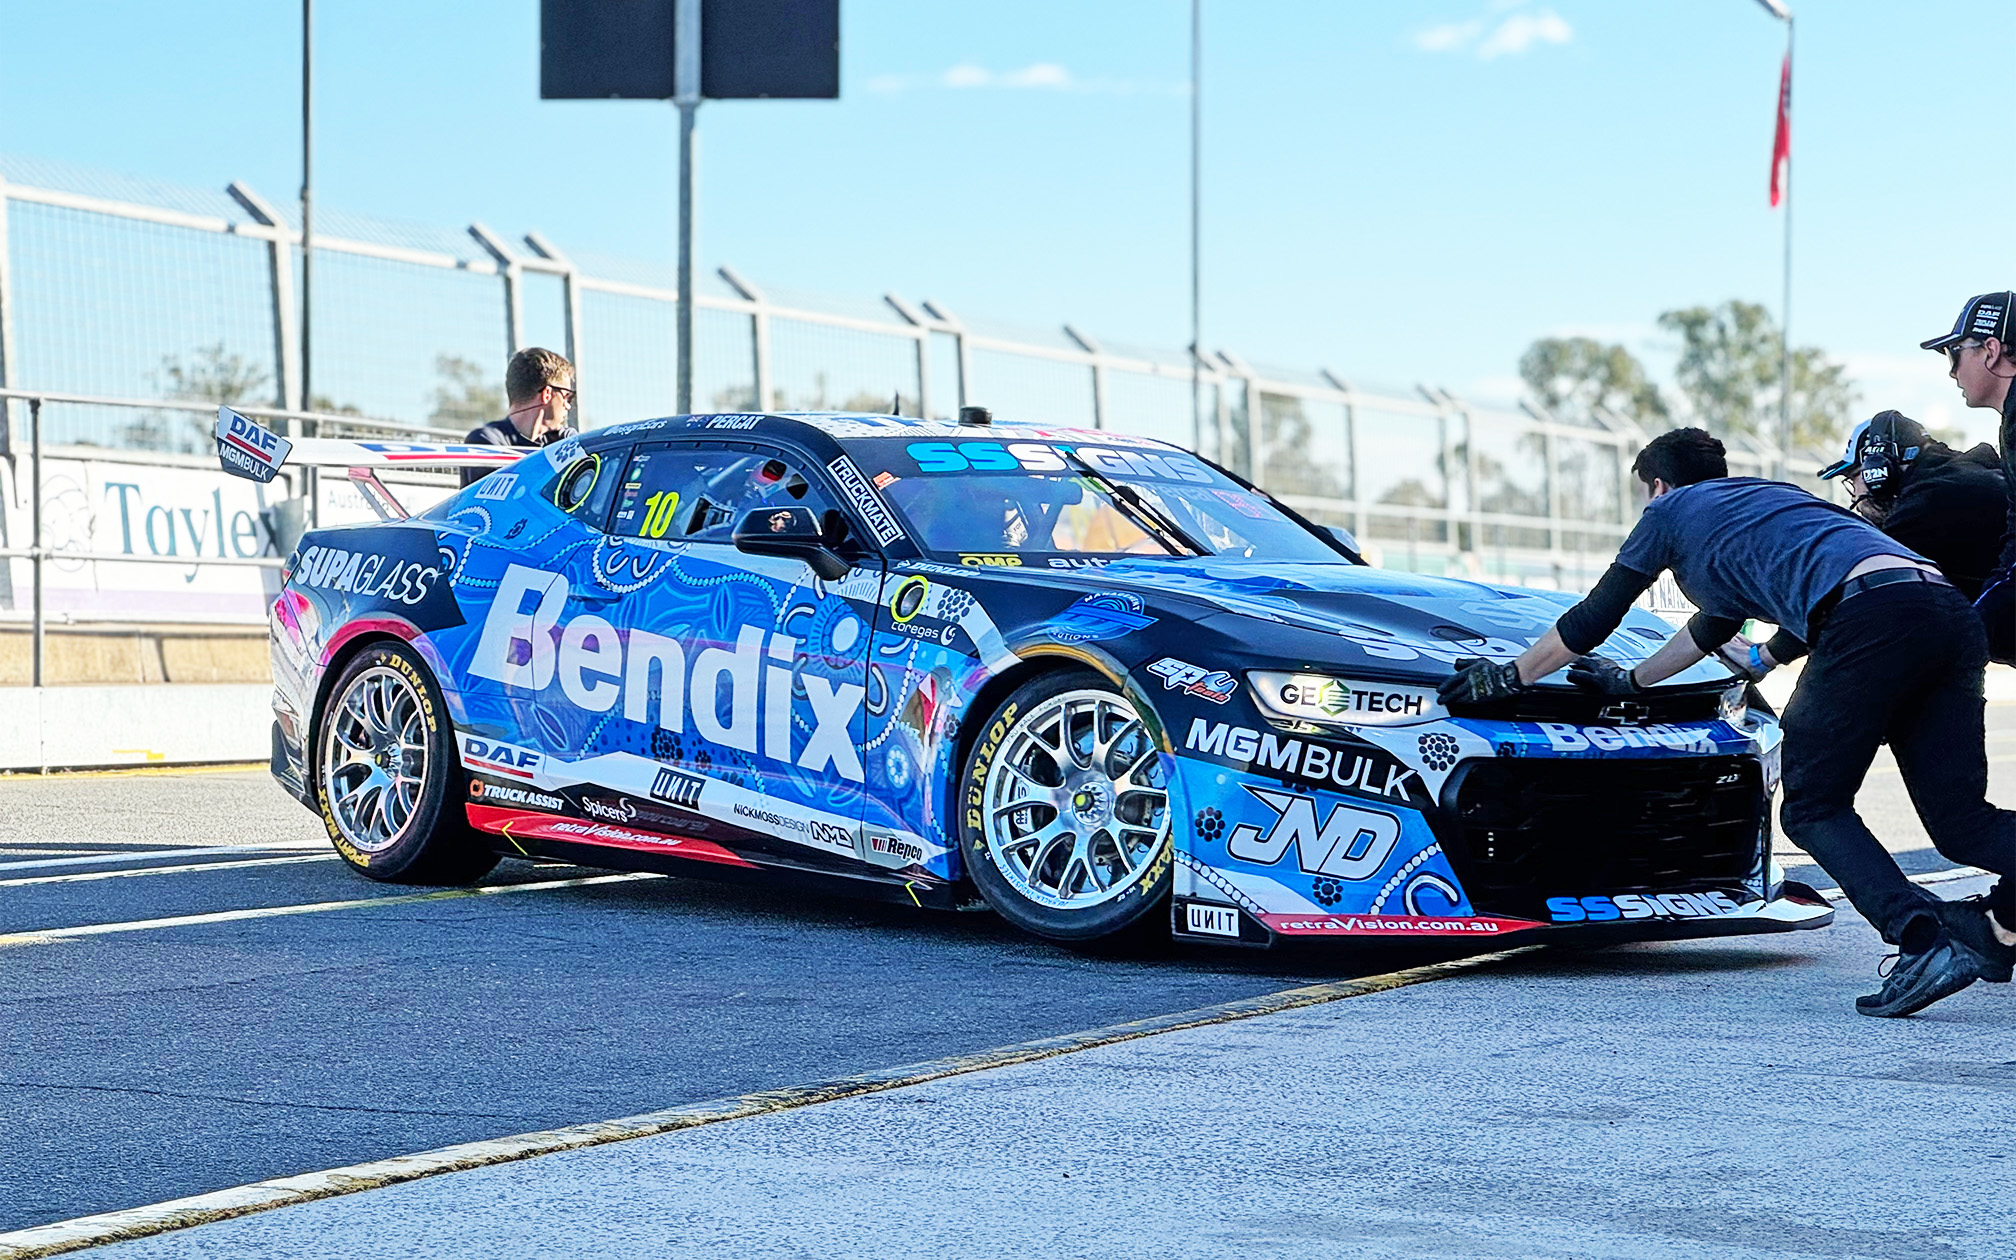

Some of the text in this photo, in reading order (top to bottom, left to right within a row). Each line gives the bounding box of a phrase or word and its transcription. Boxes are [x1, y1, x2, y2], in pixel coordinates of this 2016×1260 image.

[230, 414, 278, 451] DAF
[706, 415, 766, 430] PERCAT
[219, 442, 270, 481] MGMBULK
[638, 490, 680, 539] 10
[833, 458, 897, 541] TRUCKMATE
[104, 481, 285, 584] Taylex
[298, 544, 438, 606] SUPAGLASS
[907, 562, 981, 577] DUNLOP
[960, 556, 1023, 568] OMP
[890, 621, 939, 639] coregas
[467, 562, 866, 784] Bendix
[389, 653, 438, 733] DUNLOP
[465, 737, 541, 769] DAF
[1538, 721, 1720, 754] Bendix
[966, 703, 1018, 831] DUNLOP
[1185, 717, 1419, 803] MGMBULK
[581, 795, 629, 823] Spicers
[733, 803, 810, 834] NICKMOSSDESIGN
[551, 821, 683, 846] retraVision.com.au
[1228, 782, 1401, 880] JND
[887, 837, 923, 862] Repco
[1280, 916, 1499, 933] retraVision.com.au
